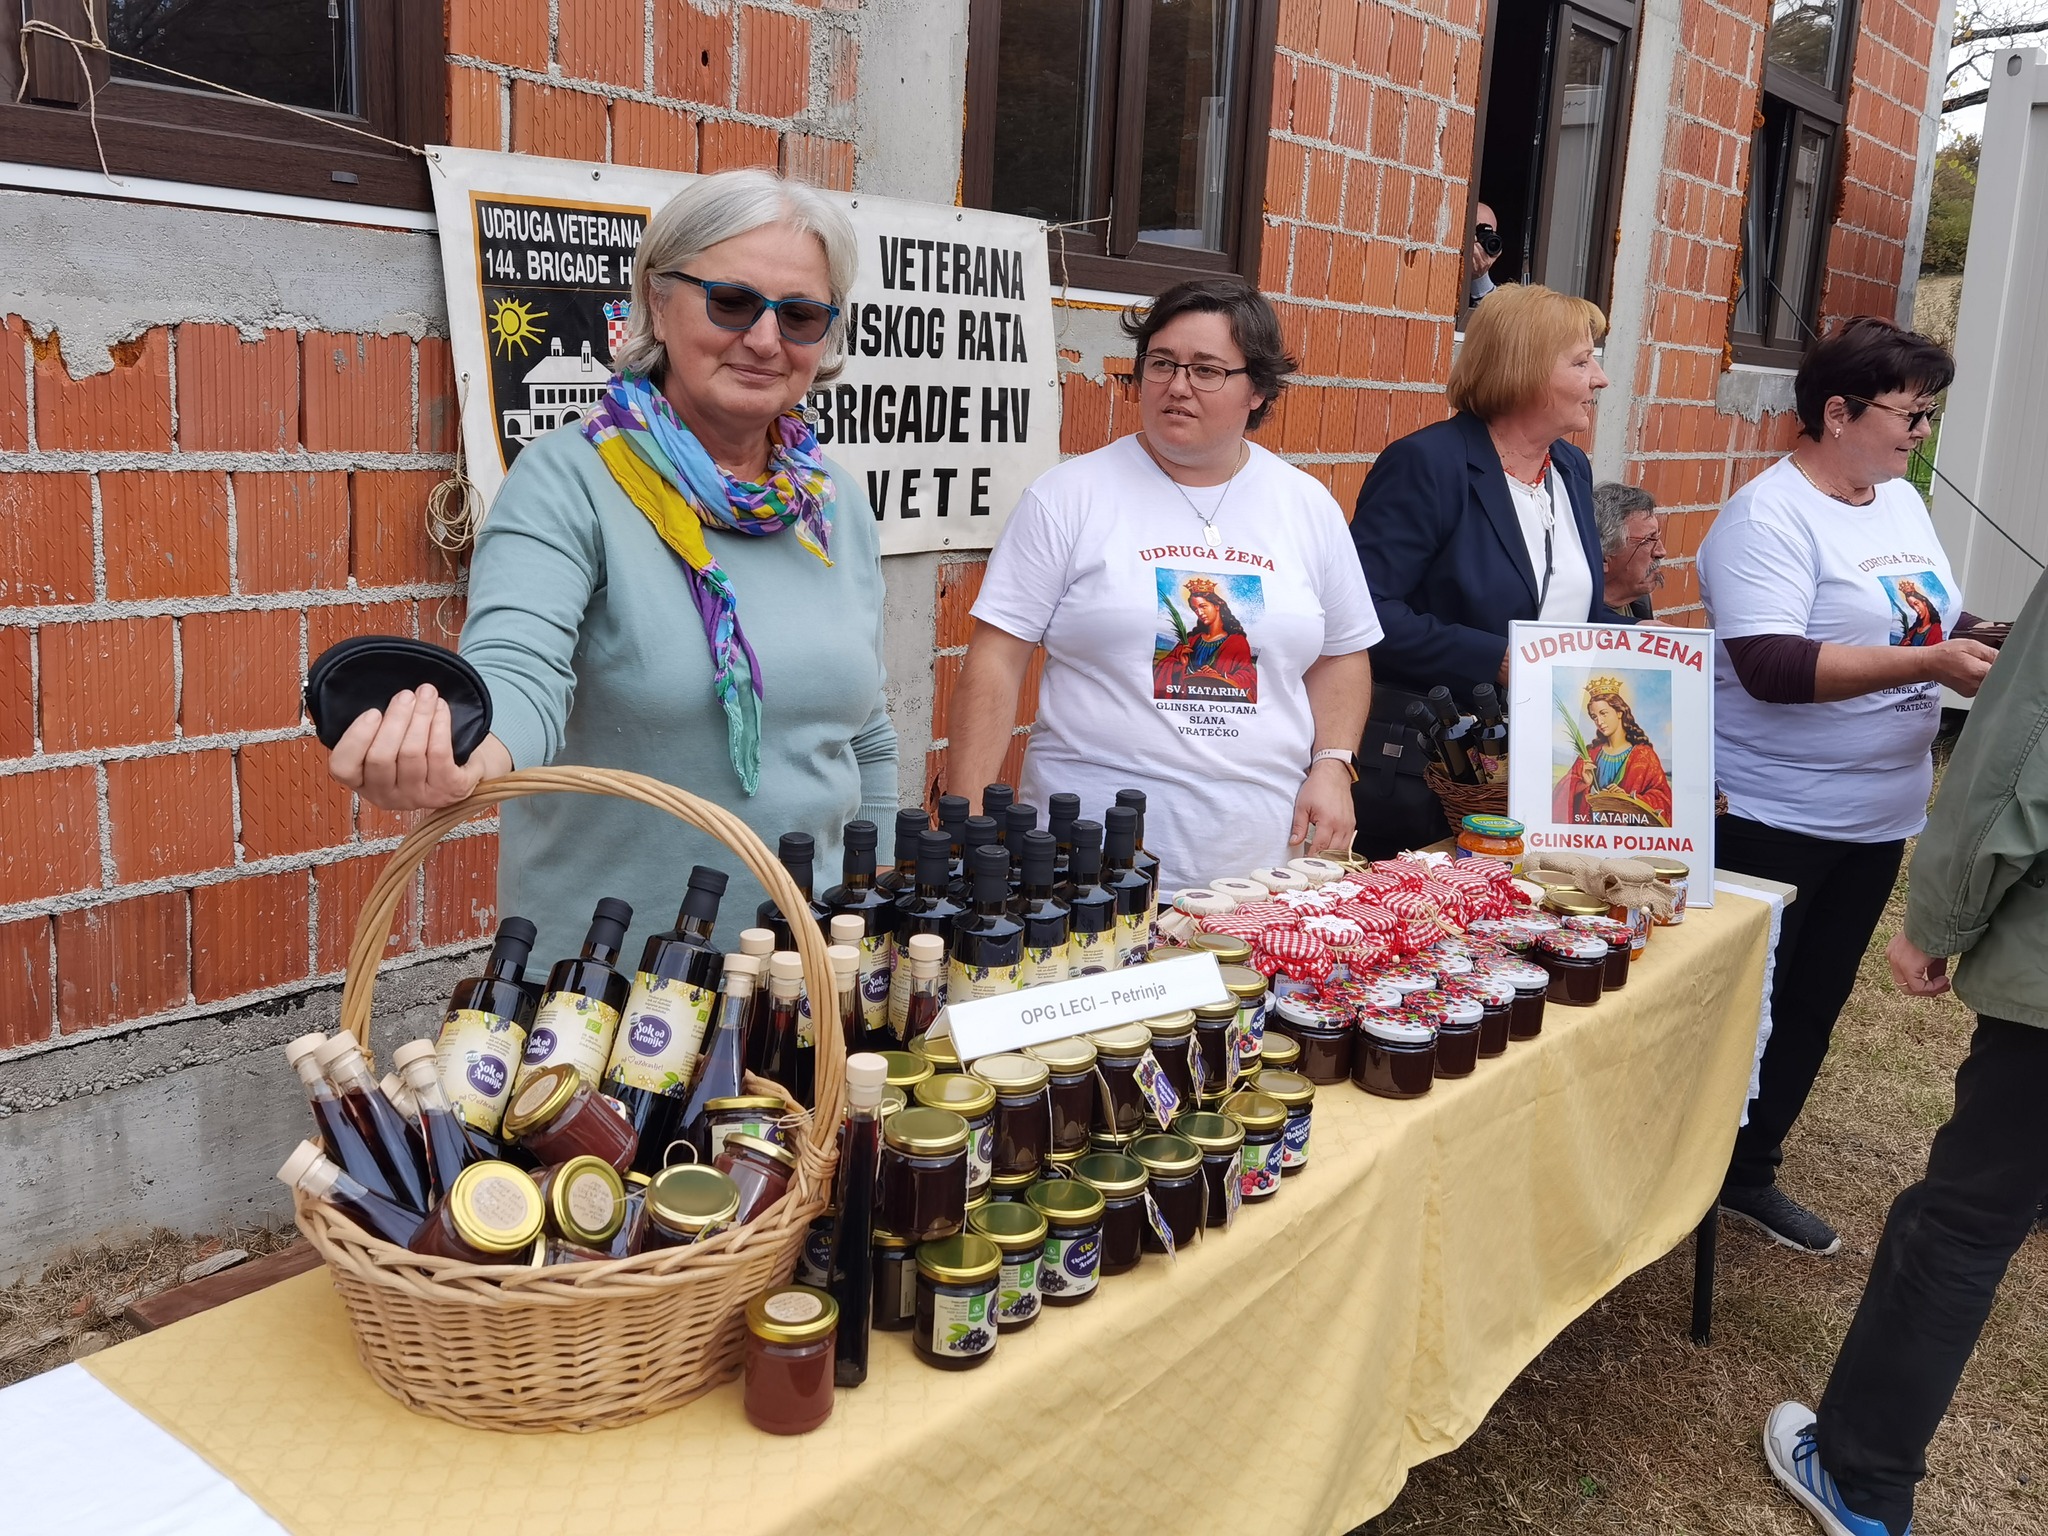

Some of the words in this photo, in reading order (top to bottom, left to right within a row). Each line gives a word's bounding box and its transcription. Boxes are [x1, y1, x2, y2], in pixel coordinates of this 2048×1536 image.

[481, 206, 554, 243] UDRUGA
[559, 213, 642, 248] VETERANA
[485, 249, 521, 280] 144.
[527, 250, 611, 284] BRIGADE
[619, 255, 637, 286] H
[879, 235, 1026, 301] VETERANA
[957, 309, 1028, 363] RATA
[806, 383, 972, 445] BRIGADE
[980, 386, 1031, 444] HV
[1138, 545, 1219, 562] UDRUGA
[1224, 546, 1276, 571] ŽENA
[1858, 554, 1903, 573] UDRUGA
[1901, 551, 1937, 567] ŽENA
[1520, 629, 1631, 664] UDRUGA
[1166, 684, 1185, 694] SV.
[1187, 685, 1247, 697] KATARINA
[1155, 702, 1205, 713] GLINSKA
[1209, 705, 1258, 715] POLJANA
[1894, 701, 1933, 713] VRATEČKO
[1189, 715, 1226, 725] SLANA
[1178, 726, 1239, 738] VRATEČKO
[1592, 812, 1650, 825] KATARINA
[1529, 832, 1608, 850] GLINSKA
[1613, 835, 1694, 853] POLJANA
[1021, 1004, 1057, 1025] OPG
[1060, 996, 1097, 1017] LECI
[1111, 983, 1167, 1006] Petrinja
[632, 1027, 665, 1048] Aronije
[637, 1021, 655, 1037] Sok
[654, 1029, 665, 1039] od
[471, 1067, 502, 1089] Aronije
[478, 1060, 497, 1078] Sok
